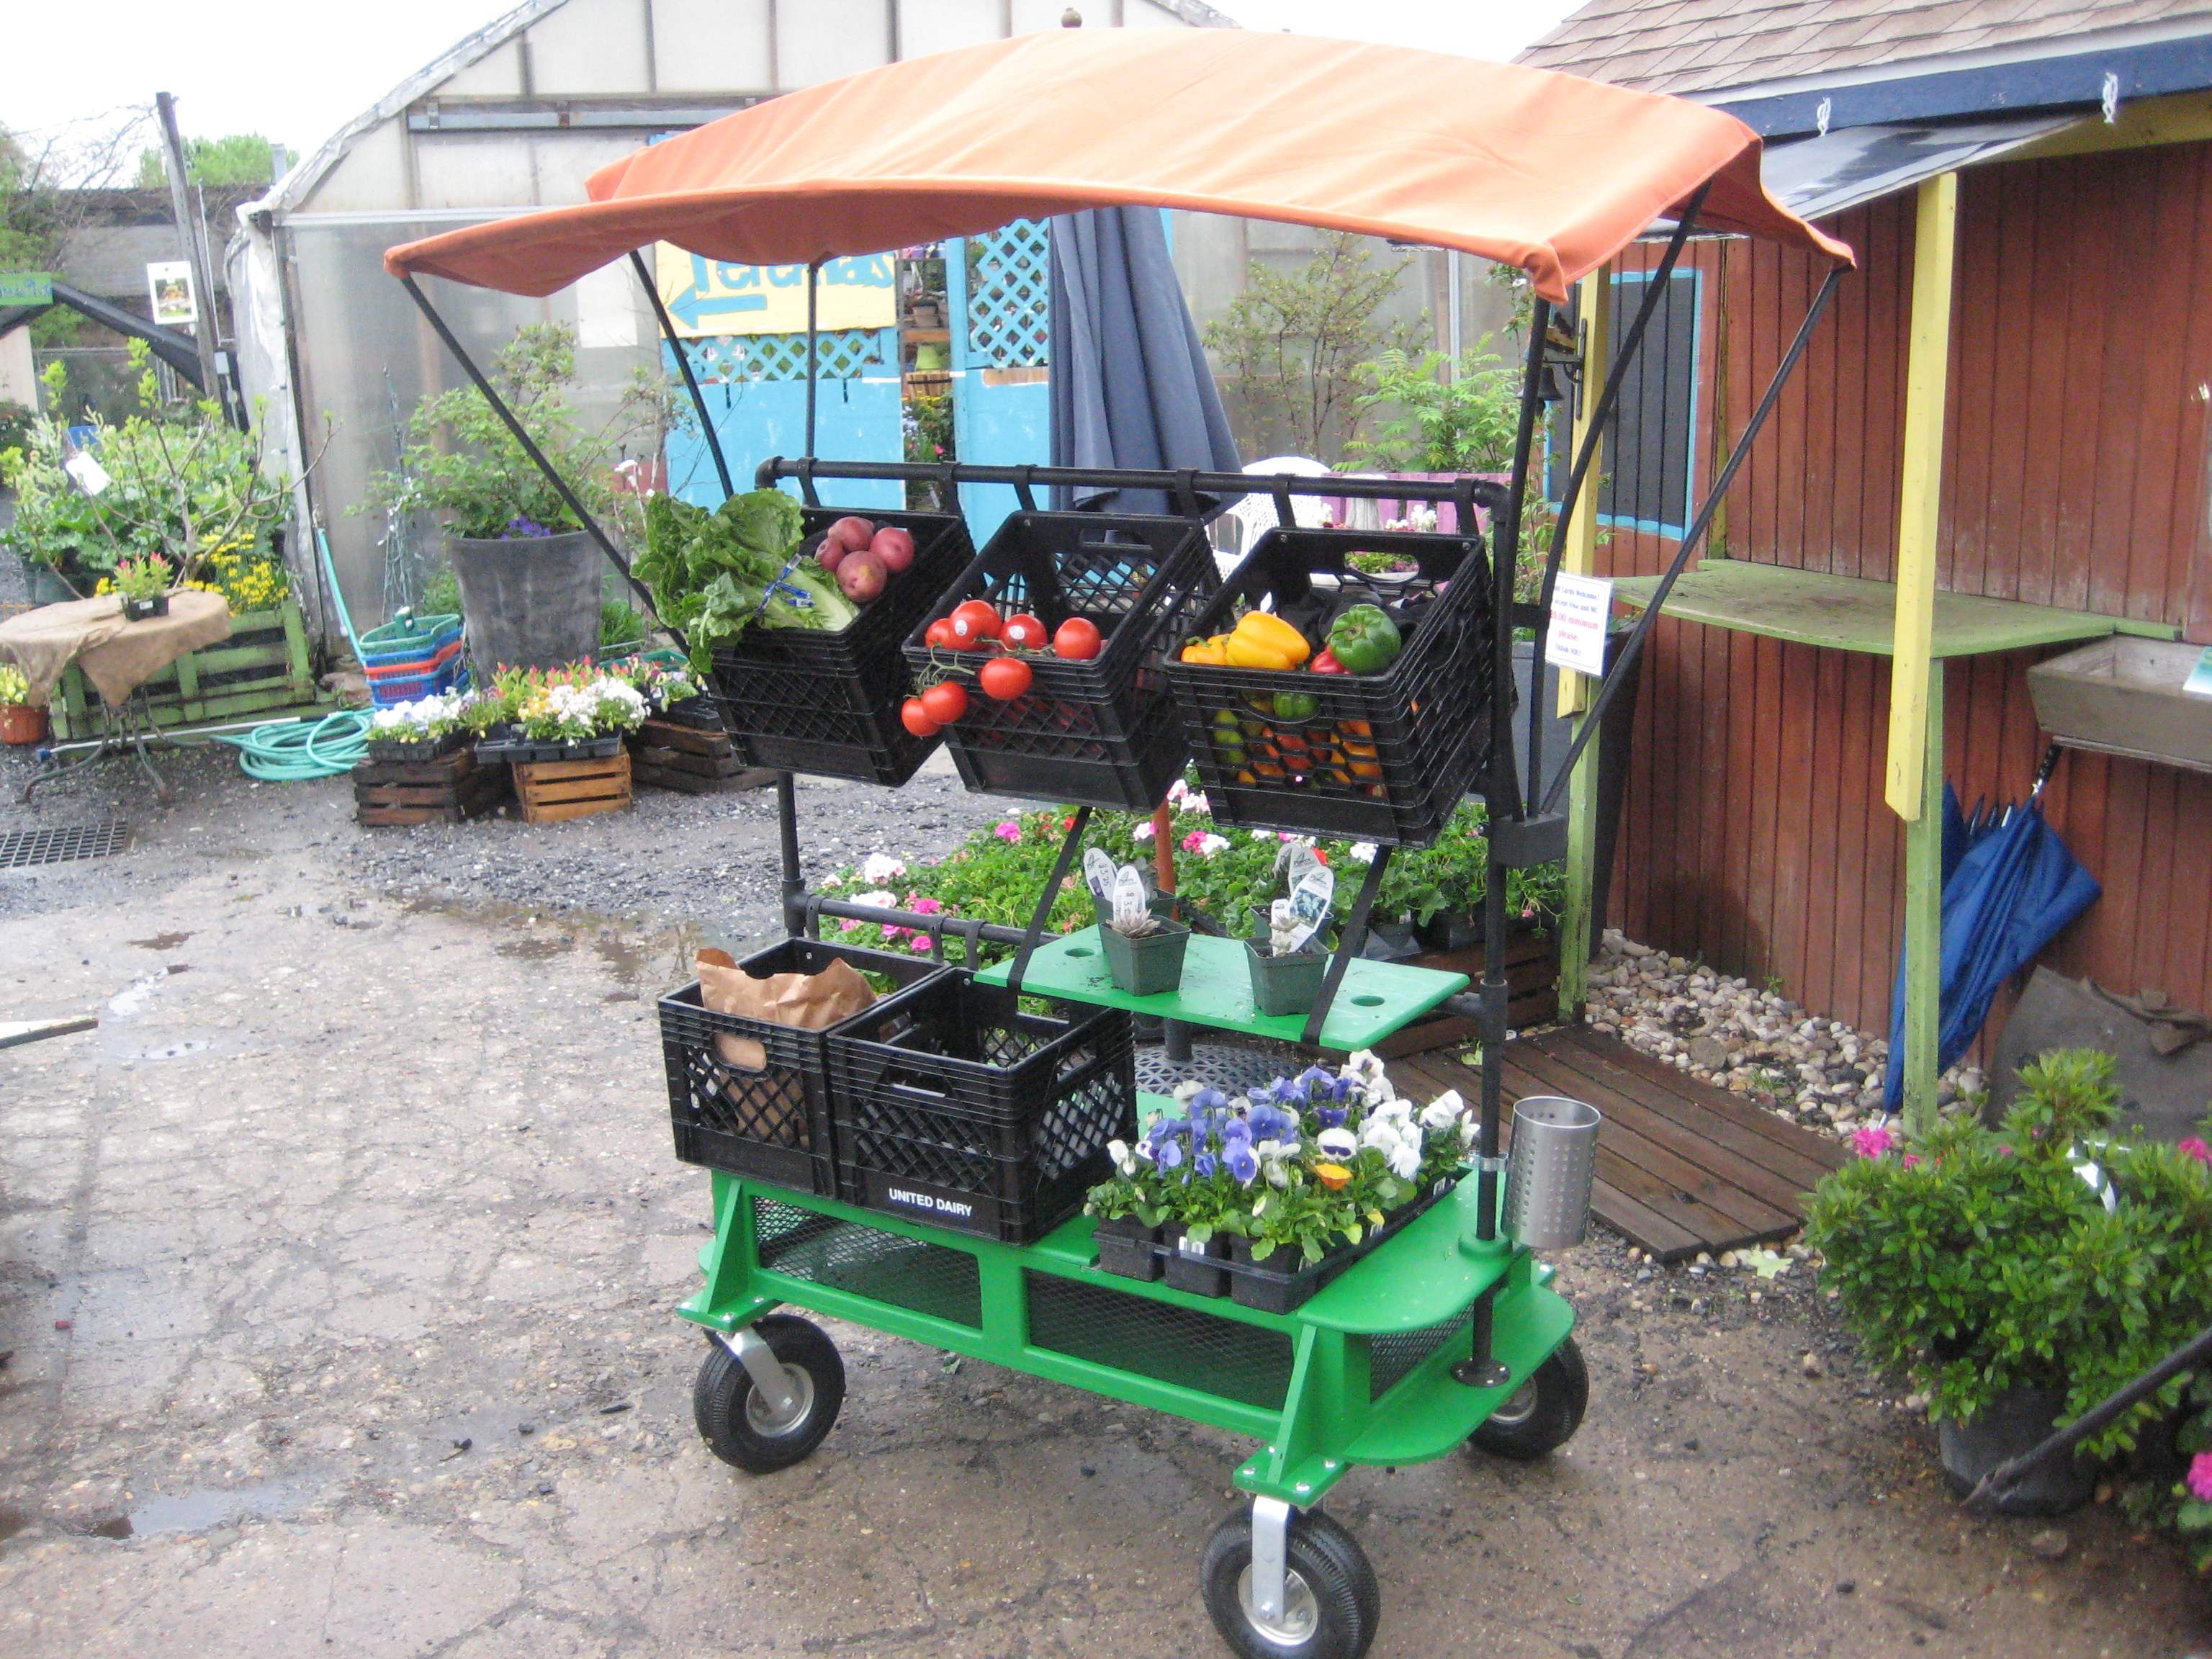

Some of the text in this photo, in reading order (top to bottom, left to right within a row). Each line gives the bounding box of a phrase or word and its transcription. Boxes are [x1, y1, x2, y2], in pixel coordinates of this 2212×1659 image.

[1568, 617, 1599, 630] minimum
[889, 1187, 972, 1217] UNITED DAIRY
